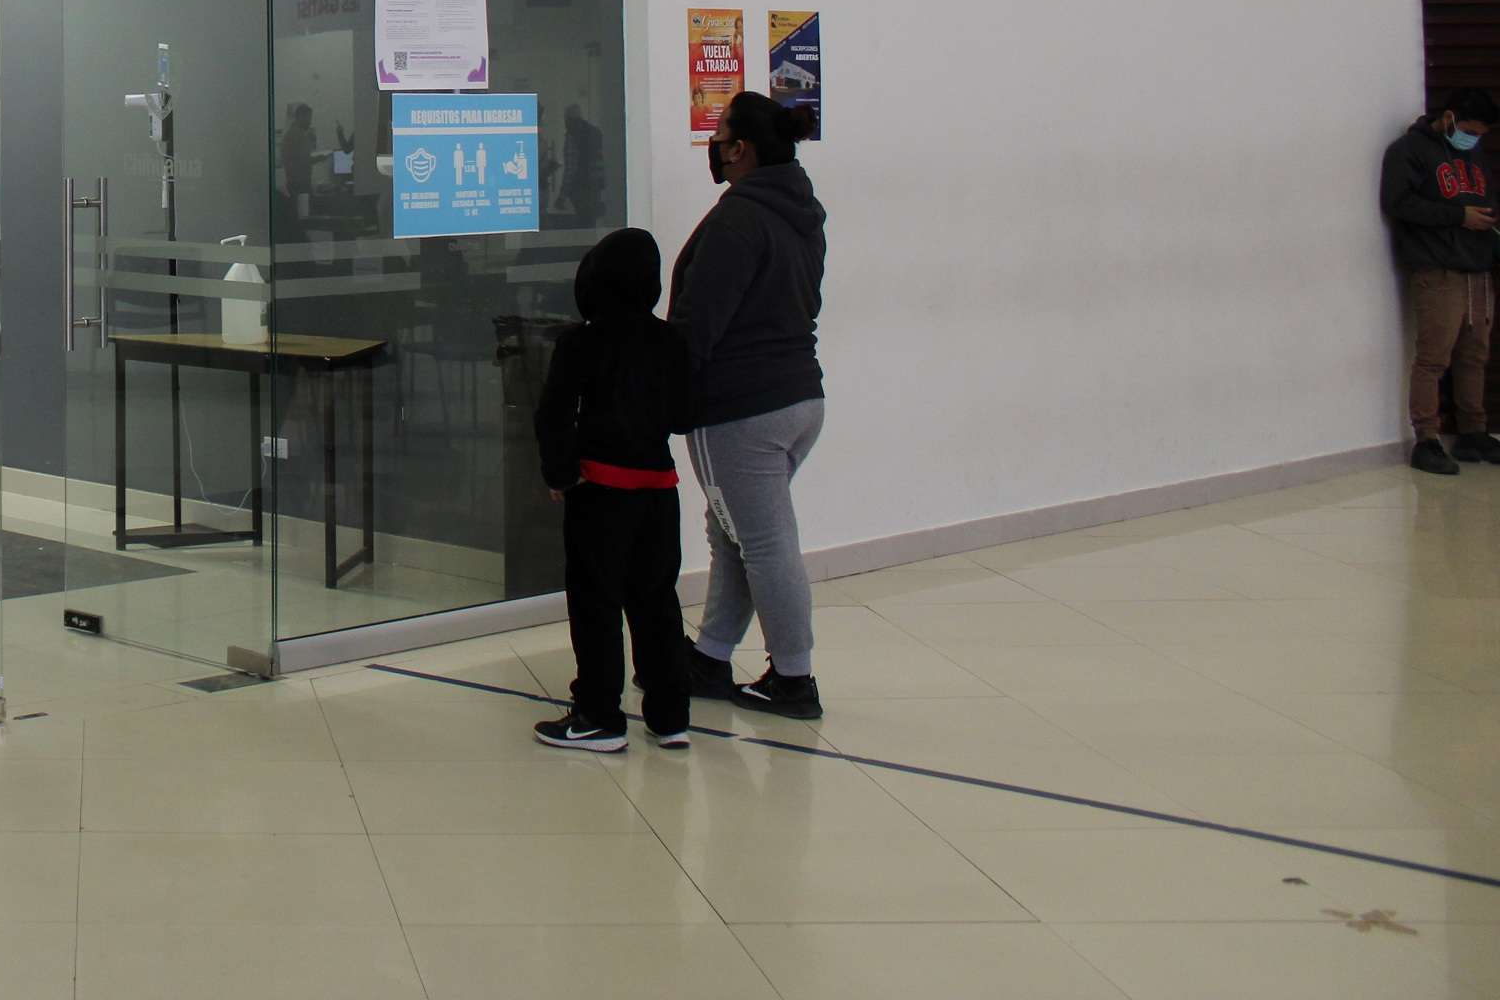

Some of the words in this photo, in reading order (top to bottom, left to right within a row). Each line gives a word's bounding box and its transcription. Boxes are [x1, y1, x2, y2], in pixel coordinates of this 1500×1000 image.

[703, 45, 730, 58] VUELTA
[696, 60, 705, 72] AL
[706, 59, 739, 72] TRABAJO
[411, 110, 460, 125] REQUISITOS
[461, 110, 483, 123] PARA
[484, 110, 522, 123] INGRESAR
